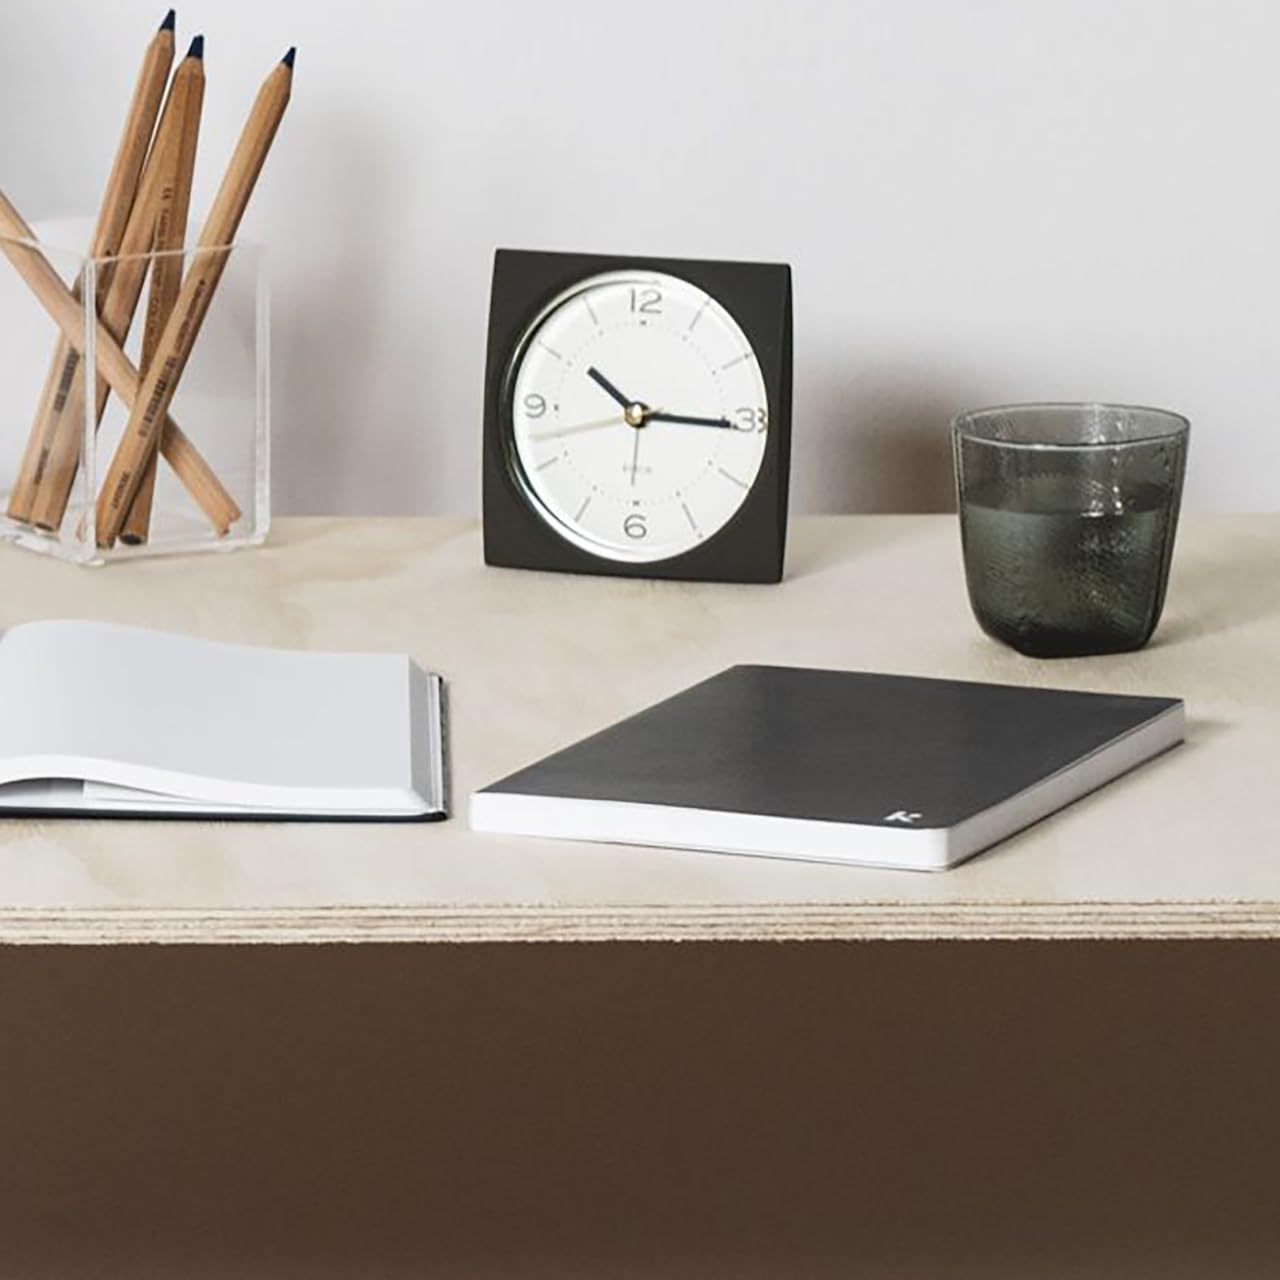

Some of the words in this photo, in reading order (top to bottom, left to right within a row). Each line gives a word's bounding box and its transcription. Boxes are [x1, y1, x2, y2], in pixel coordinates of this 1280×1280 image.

[629, 288, 663, 315] 12
[524, 394, 546, 419] 9
[624, 514, 647, 539] 6
